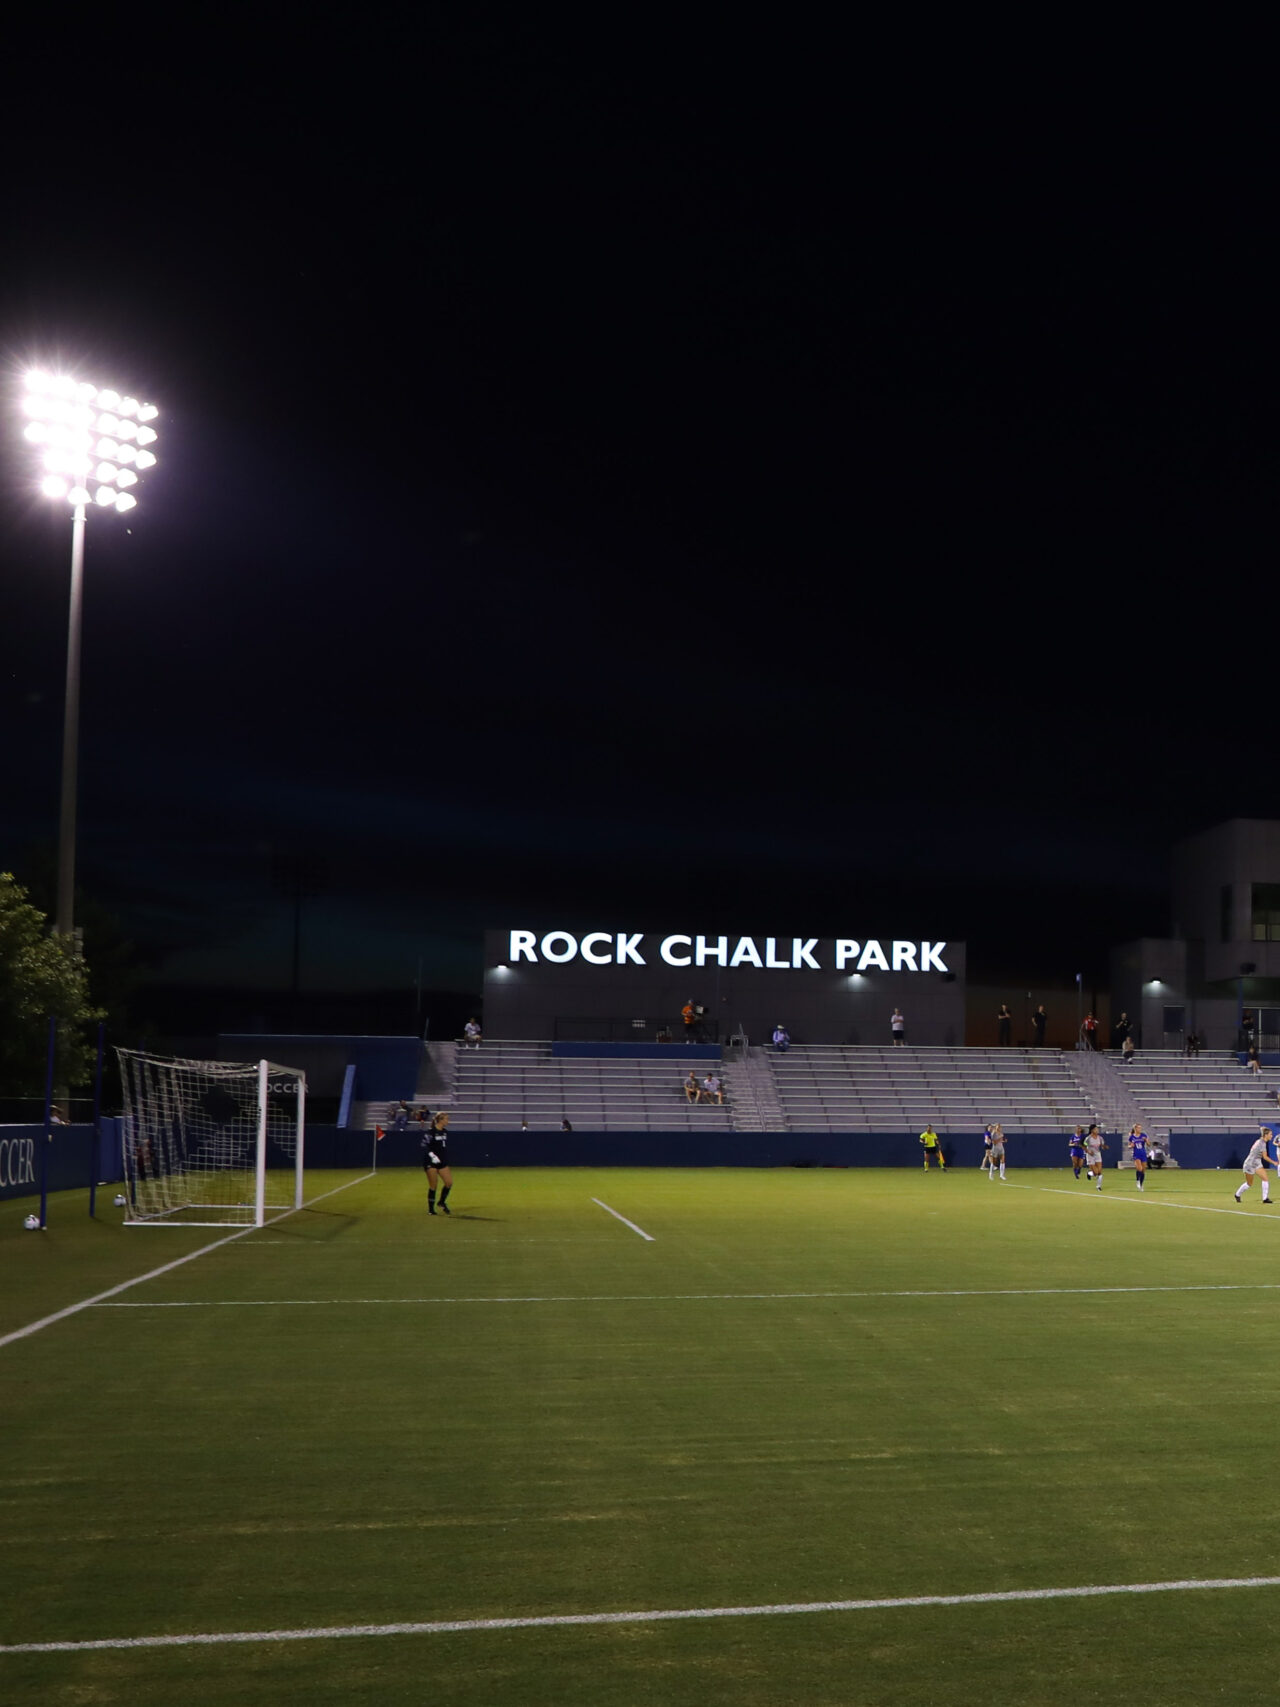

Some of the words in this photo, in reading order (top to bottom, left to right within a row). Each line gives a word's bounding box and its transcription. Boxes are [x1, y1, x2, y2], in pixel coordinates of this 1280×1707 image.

[509, 930, 647, 965] ROCK
[660, 934, 821, 969] CHALK
[835, 939, 949, 972] PARK
